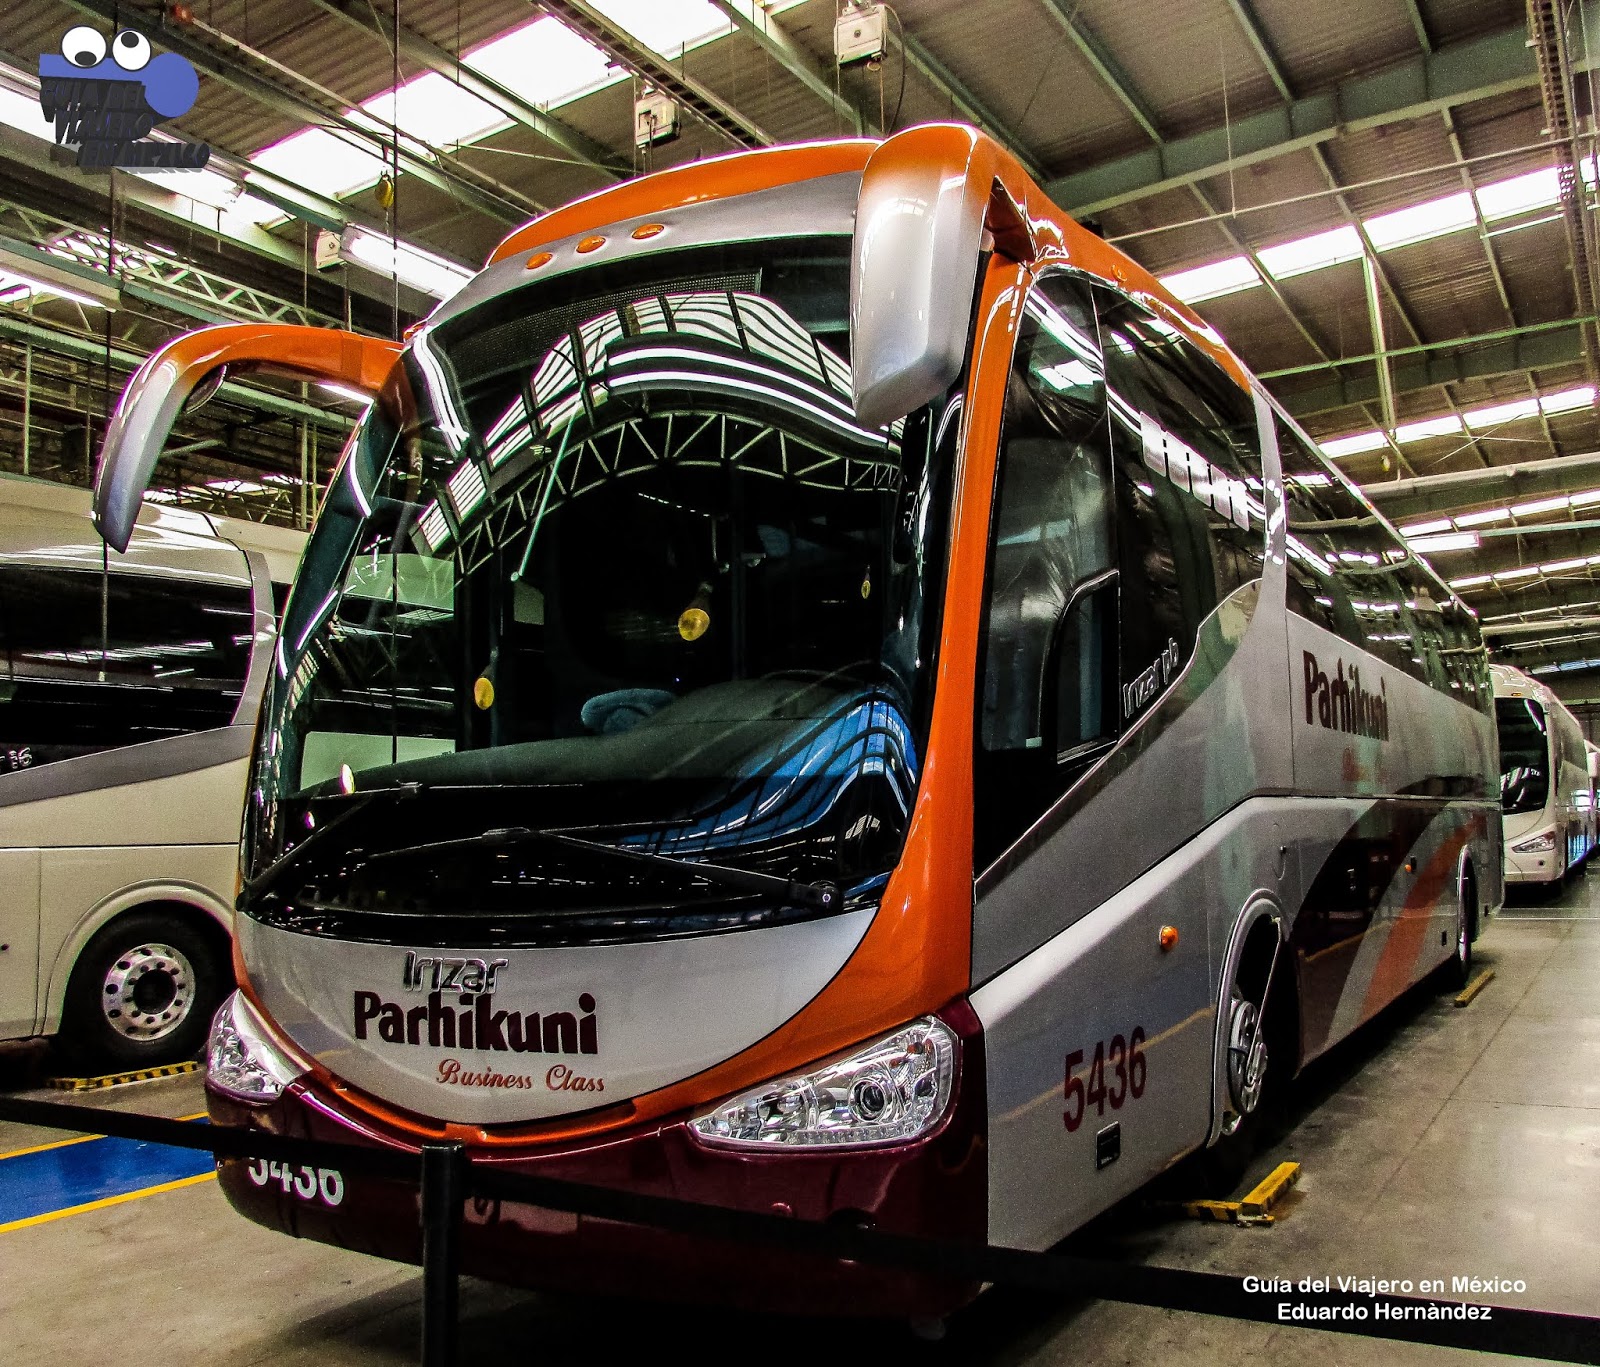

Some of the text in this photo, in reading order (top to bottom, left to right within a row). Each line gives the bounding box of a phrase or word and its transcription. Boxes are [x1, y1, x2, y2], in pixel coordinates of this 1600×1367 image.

[1122, 657, 1161, 719] Irizar
[1303, 649, 1390, 742] Parhikuni
[403, 951, 509, 993] Irizar
[353, 990, 598, 1054] Parhikuni
[436, 1058, 605, 1092] Business Class
[1063, 1025, 1147, 1133] 5436
